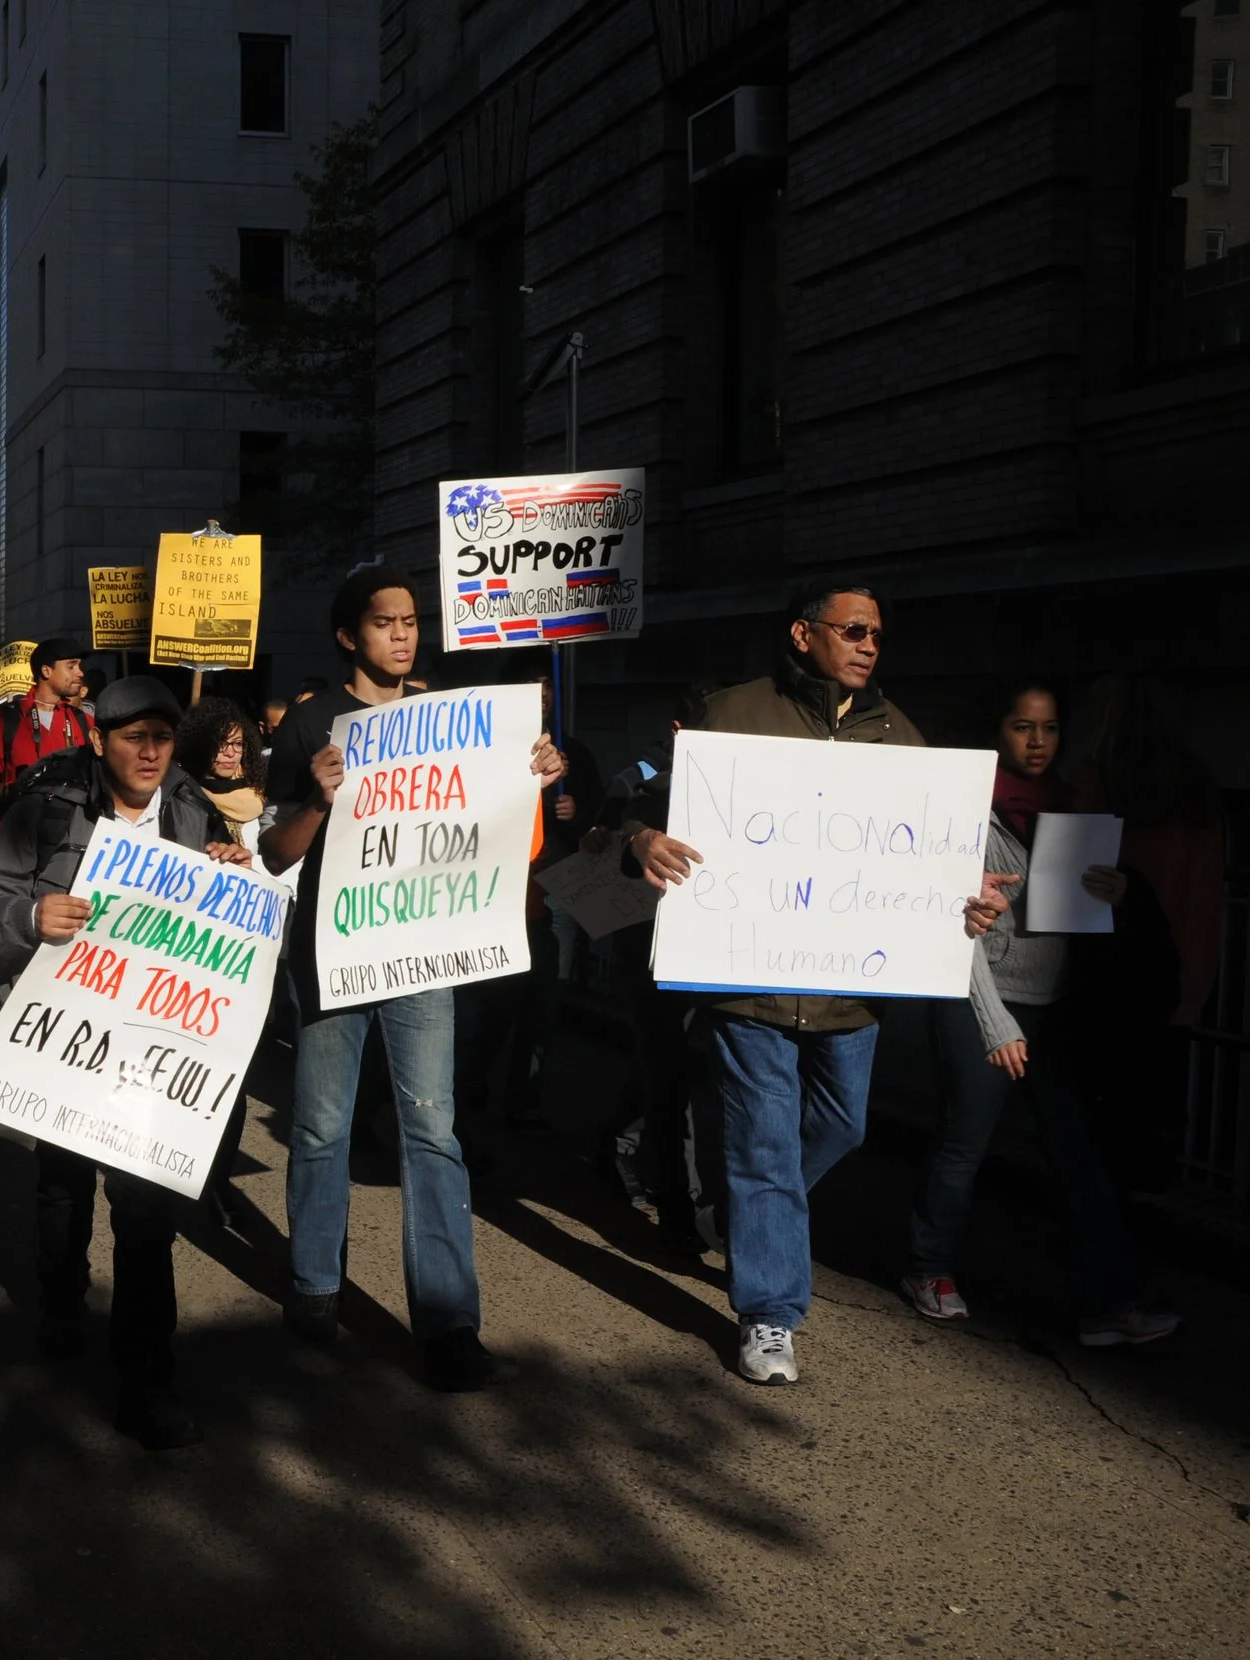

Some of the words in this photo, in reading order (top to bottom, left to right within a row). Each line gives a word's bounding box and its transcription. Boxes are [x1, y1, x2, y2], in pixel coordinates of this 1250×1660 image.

[521, 489, 644, 532] DOMINICANS
[171, 553, 222, 567] SISTERS
[230, 556, 250, 566] AND
[191, 538, 206, 548] WE
[213, 540, 234, 549] ARE
[457, 534, 623, 577] SUPPORT
[92, 571, 105, 582] LA
[108, 570, 128, 582] LEY
[93, 593, 108, 604] LA
[110, 591, 150, 604] LUCHA
[95, 582, 146, 591] CRIMINALIZA
[168, 586, 182, 596] OF
[191, 589, 212, 600] THE
[221, 591, 248, 601] SAME
[181, 570, 239, 584] BROTHERS
[96, 610, 115, 619] NOS
[159, 602, 216, 619] ISLAND
[344, 689, 492, 769] REVOLUCIÓN
[353, 763, 466, 820] OBRERA
[361, 822, 399, 869] EN
[414, 821, 479, 867] TODA
[196, 871, 286, 942] DERECHOS
[694, 869, 741, 911] es
[829, 869, 967, 918] derecho
[86, 890, 120, 932] DE
[110, 902, 258, 985] CIUDADANÍA
[727, 922, 887, 977] Humano
[55, 940, 129, 1000] PARA
[136, 966, 230, 1038] TODOS
[329, 964, 378, 998] GRUPO
[382, 945, 510, 993] INTERNCIONALISTA
[9, 1001, 66, 1053] EN
[52, 1104, 196, 1179] INTERNACIONALISTA
